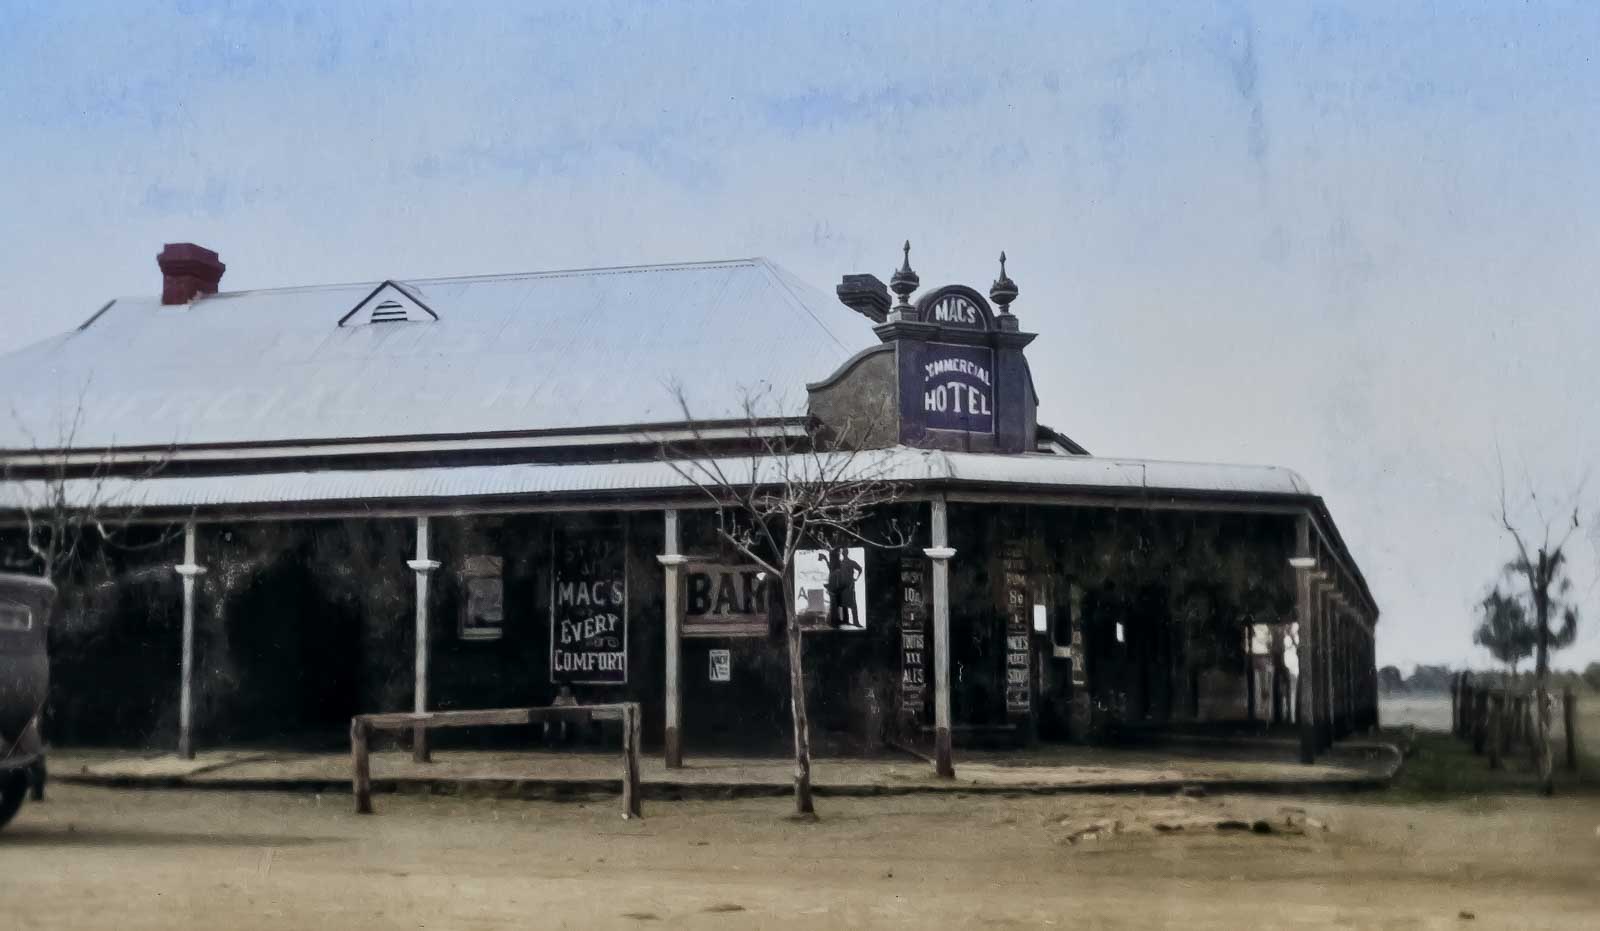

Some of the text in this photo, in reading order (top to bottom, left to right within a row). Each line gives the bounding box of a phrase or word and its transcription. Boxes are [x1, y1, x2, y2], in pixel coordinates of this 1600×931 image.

[924, 381, 991, 416] HOTEL
[686, 571, 768, 615] BAR
[560, 612, 621, 645] EVERY
[554, 649, 626, 672] COMFORT
